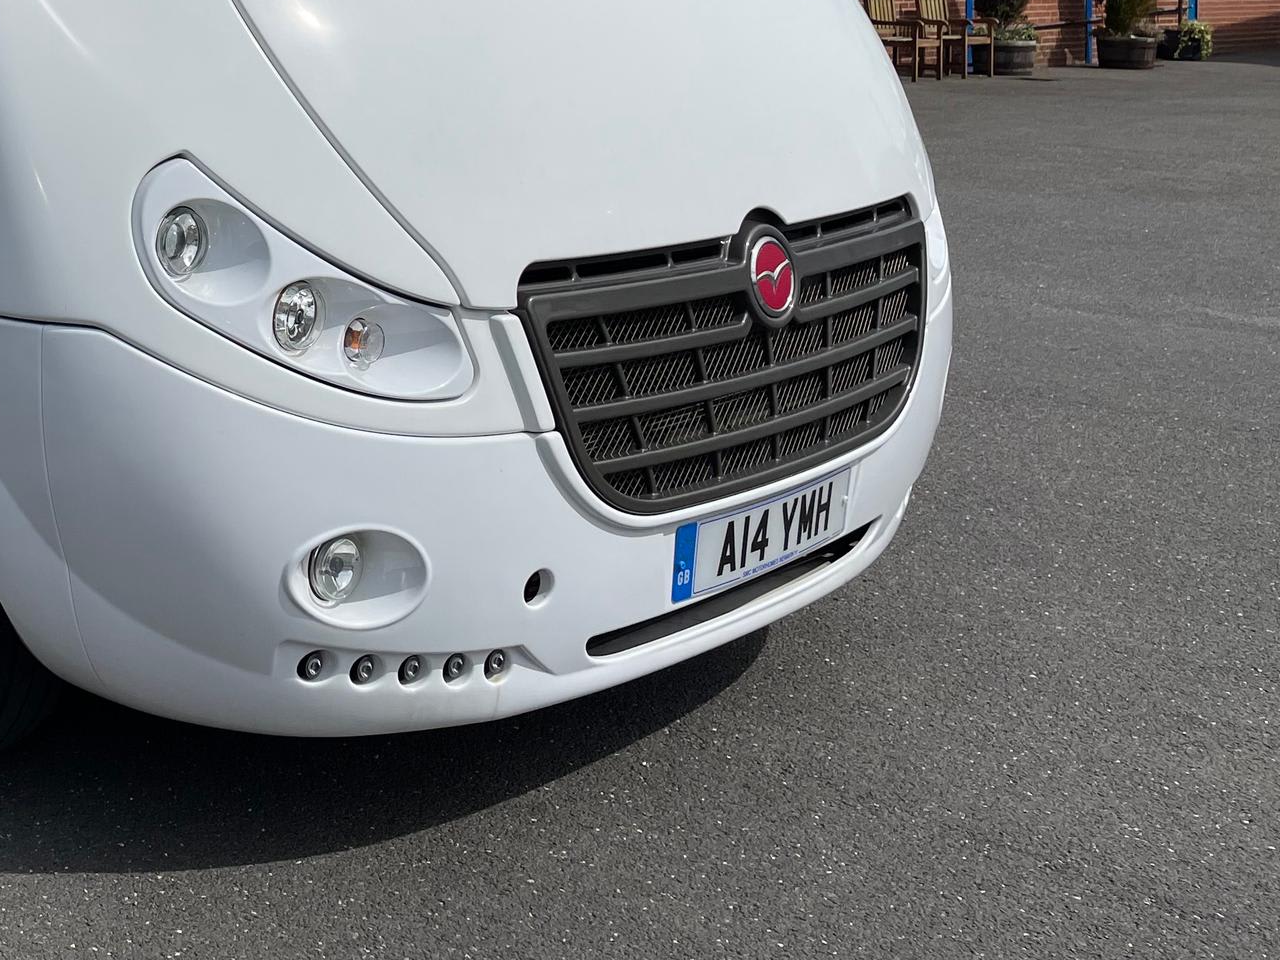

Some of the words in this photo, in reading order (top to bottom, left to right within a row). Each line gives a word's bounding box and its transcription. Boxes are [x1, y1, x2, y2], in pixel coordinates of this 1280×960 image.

[716, 508, 770, 577] A14
[782, 481, 834, 551] YMH
[677, 569, 690, 586] GB
